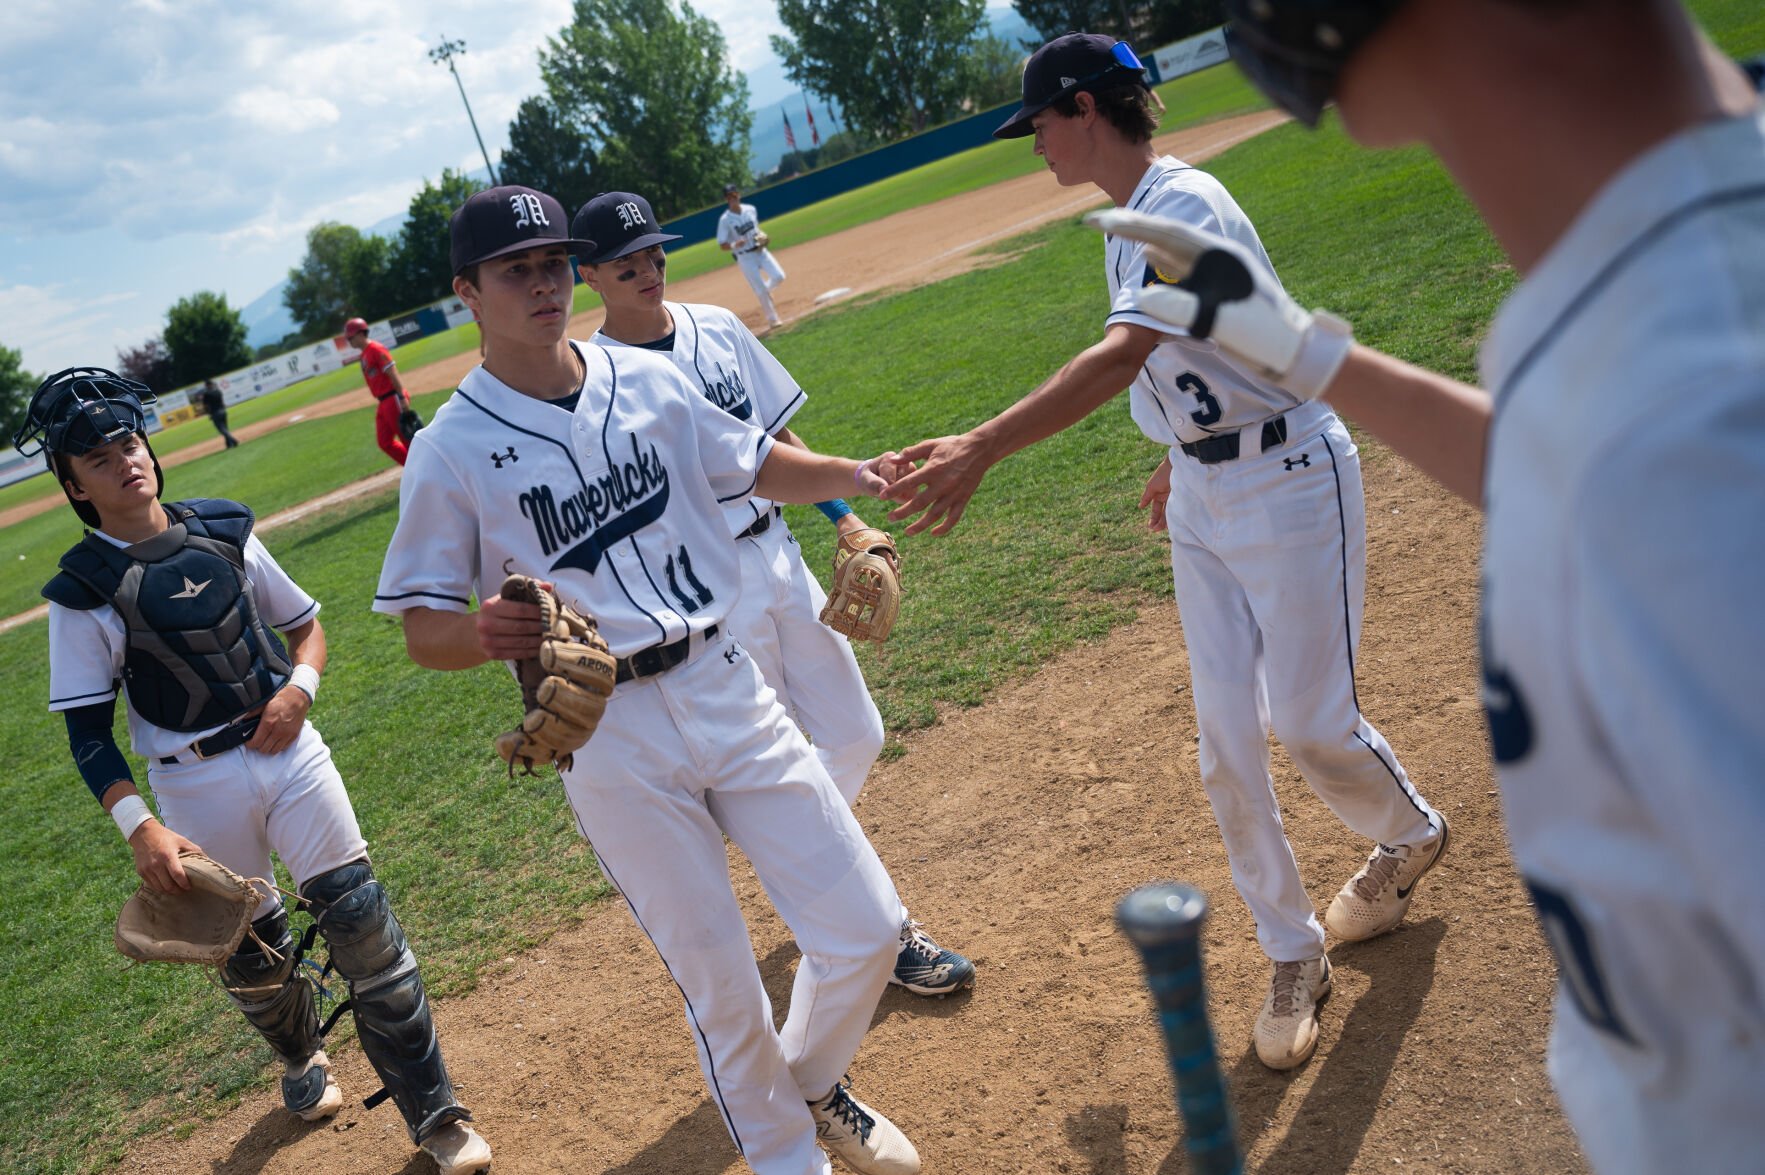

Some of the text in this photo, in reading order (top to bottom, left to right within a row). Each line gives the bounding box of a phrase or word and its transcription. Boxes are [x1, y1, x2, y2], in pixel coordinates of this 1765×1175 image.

[1175, 369, 1223, 427] 3
[519, 432, 666, 557] Mavericks
[665, 544, 715, 615] 11
